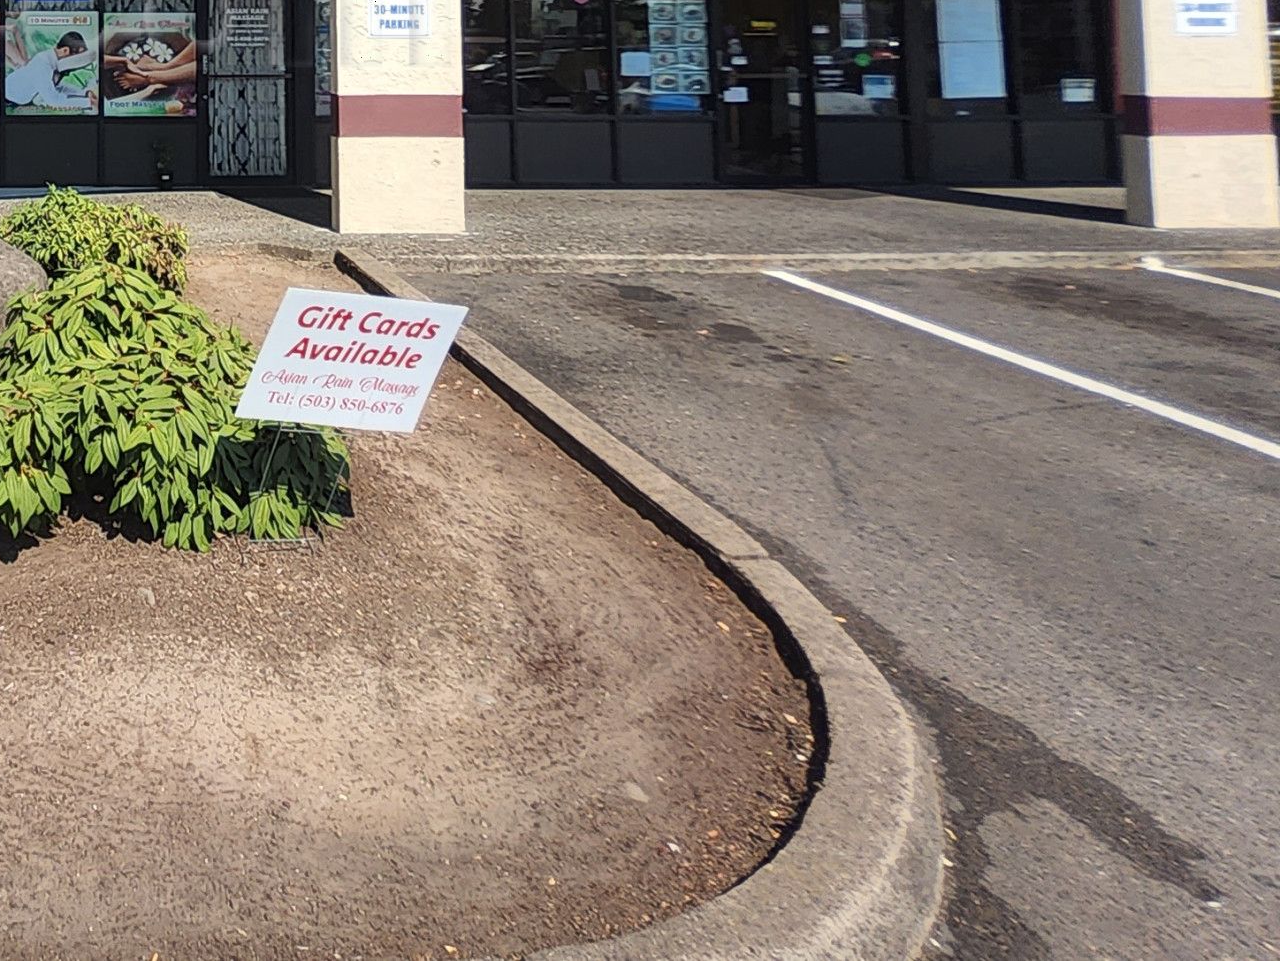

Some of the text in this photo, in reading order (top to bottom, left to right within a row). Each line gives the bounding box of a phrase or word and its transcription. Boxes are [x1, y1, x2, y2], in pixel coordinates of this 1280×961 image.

[374, 4, 424, 15] 30-MINUTE
[379, 19, 419, 29] PARKING
[297, 306, 441, 340] Gift Cards
[284, 337, 423, 369] Available
[261, 369, 421, 396] Asian Rain Massage
[268, 390, 404, 415] Tel: (503) 850-6876
